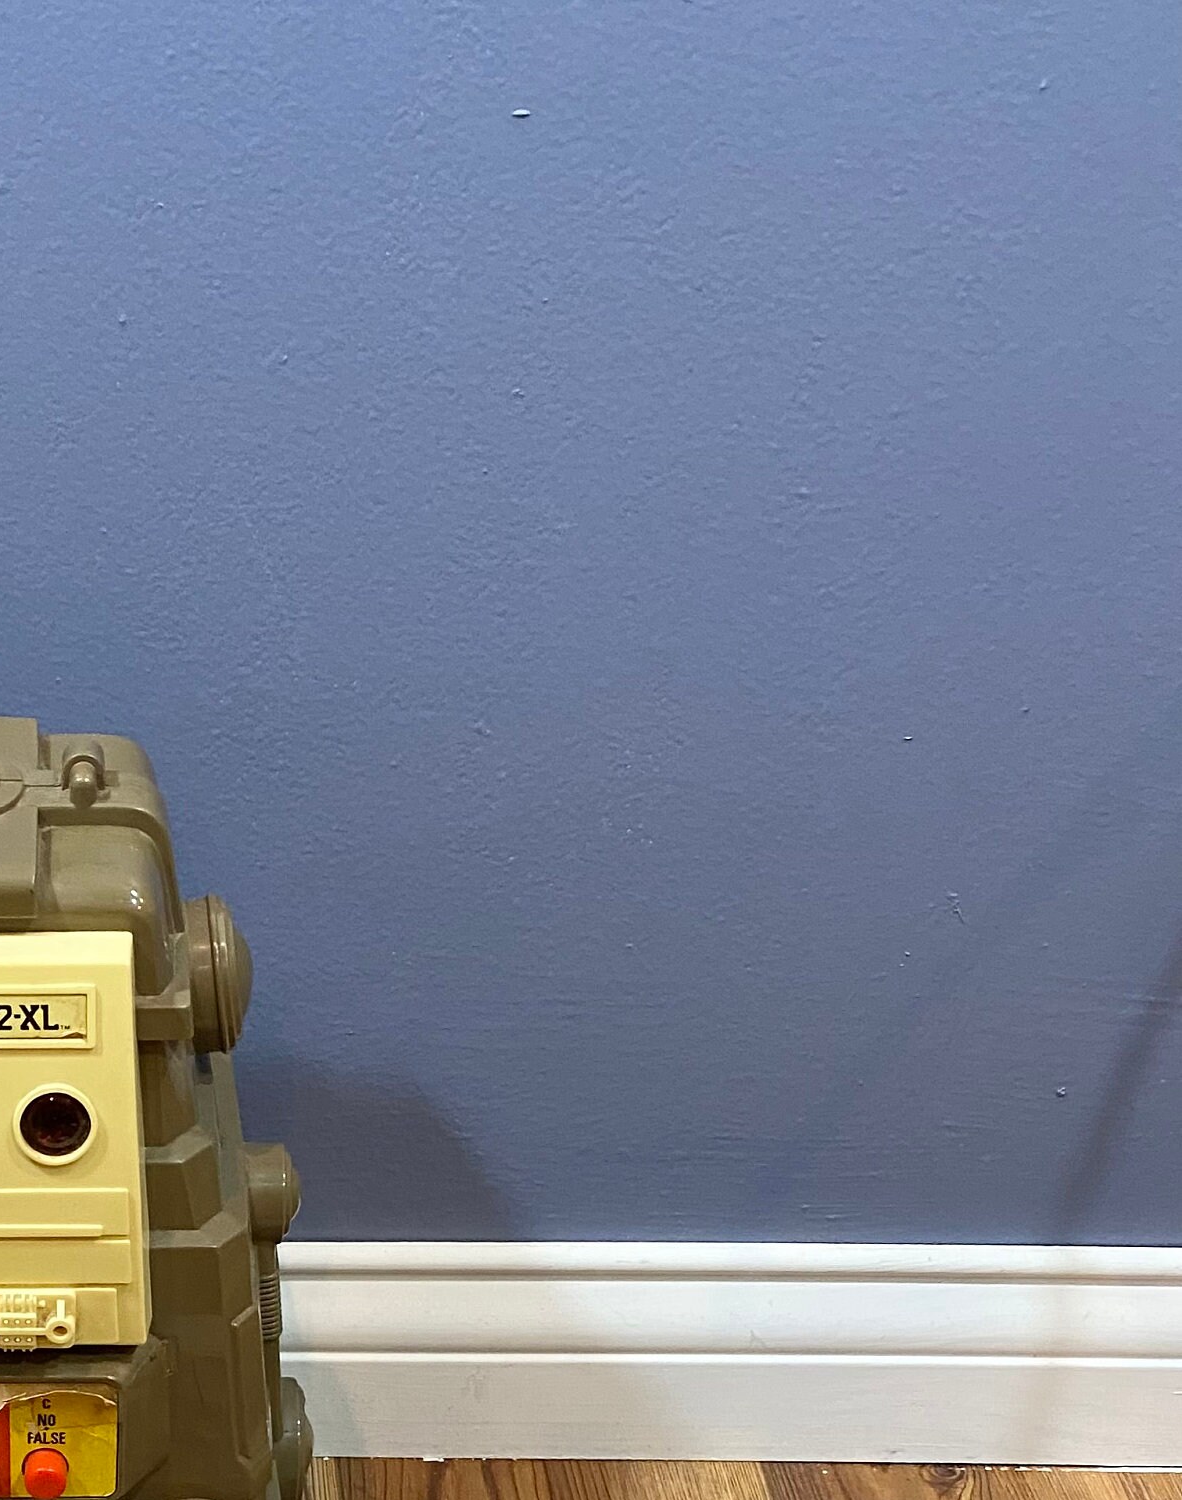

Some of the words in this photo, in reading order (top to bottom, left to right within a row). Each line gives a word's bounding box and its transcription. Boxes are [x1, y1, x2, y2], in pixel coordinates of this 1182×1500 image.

[42, 1398, 51, 1409] C
[37, 1413, 56, 1427] NO
[27, 1431, 66, 1445] FALSE
